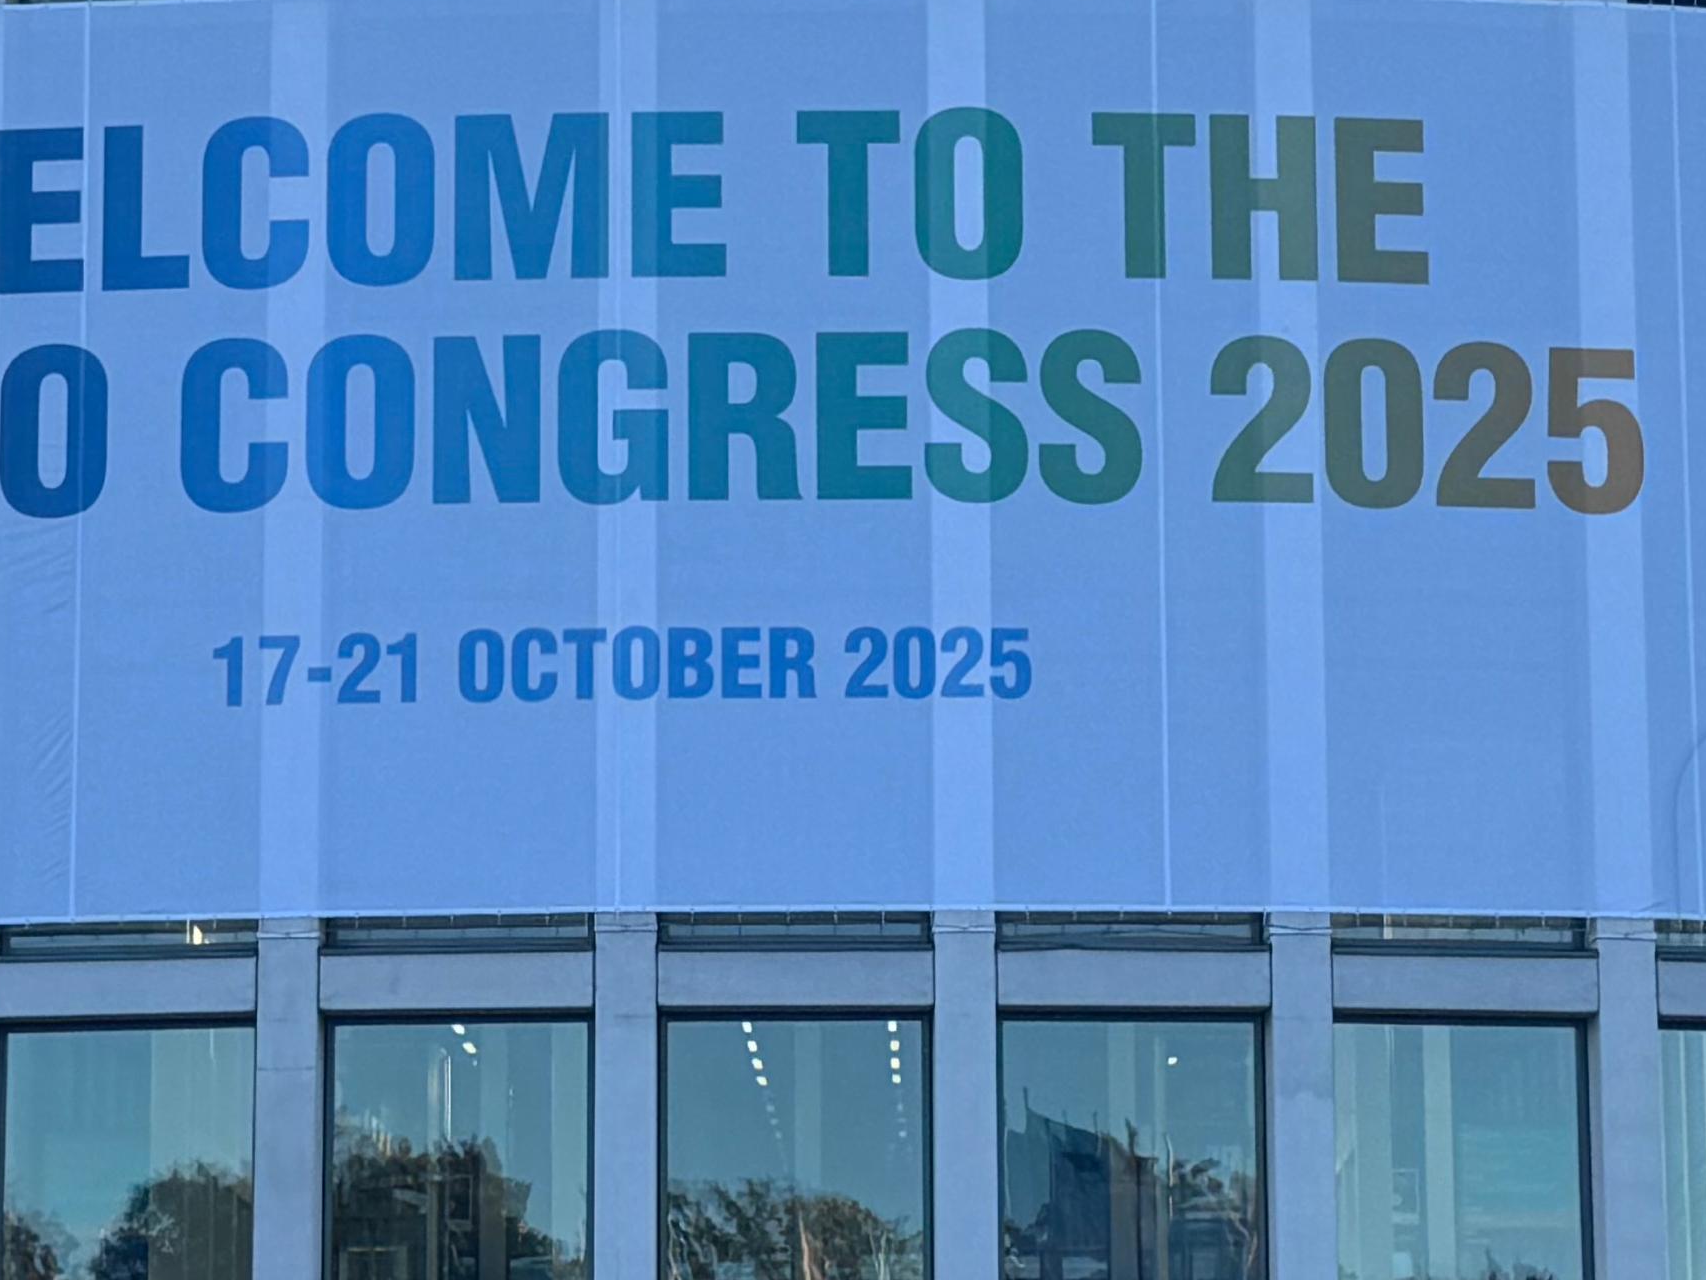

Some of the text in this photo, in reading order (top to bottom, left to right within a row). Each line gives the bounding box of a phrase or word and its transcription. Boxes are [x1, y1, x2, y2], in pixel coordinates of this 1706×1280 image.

[796, 106, 1024, 280] TO
[1091, 112, 1430, 285] THE
[179, 327, 1143, 513] CONGRESS
[1209, 335, 1645, 516] 2025
[211, 625, 1033, 708] 17-21 OCTOBER 2025
